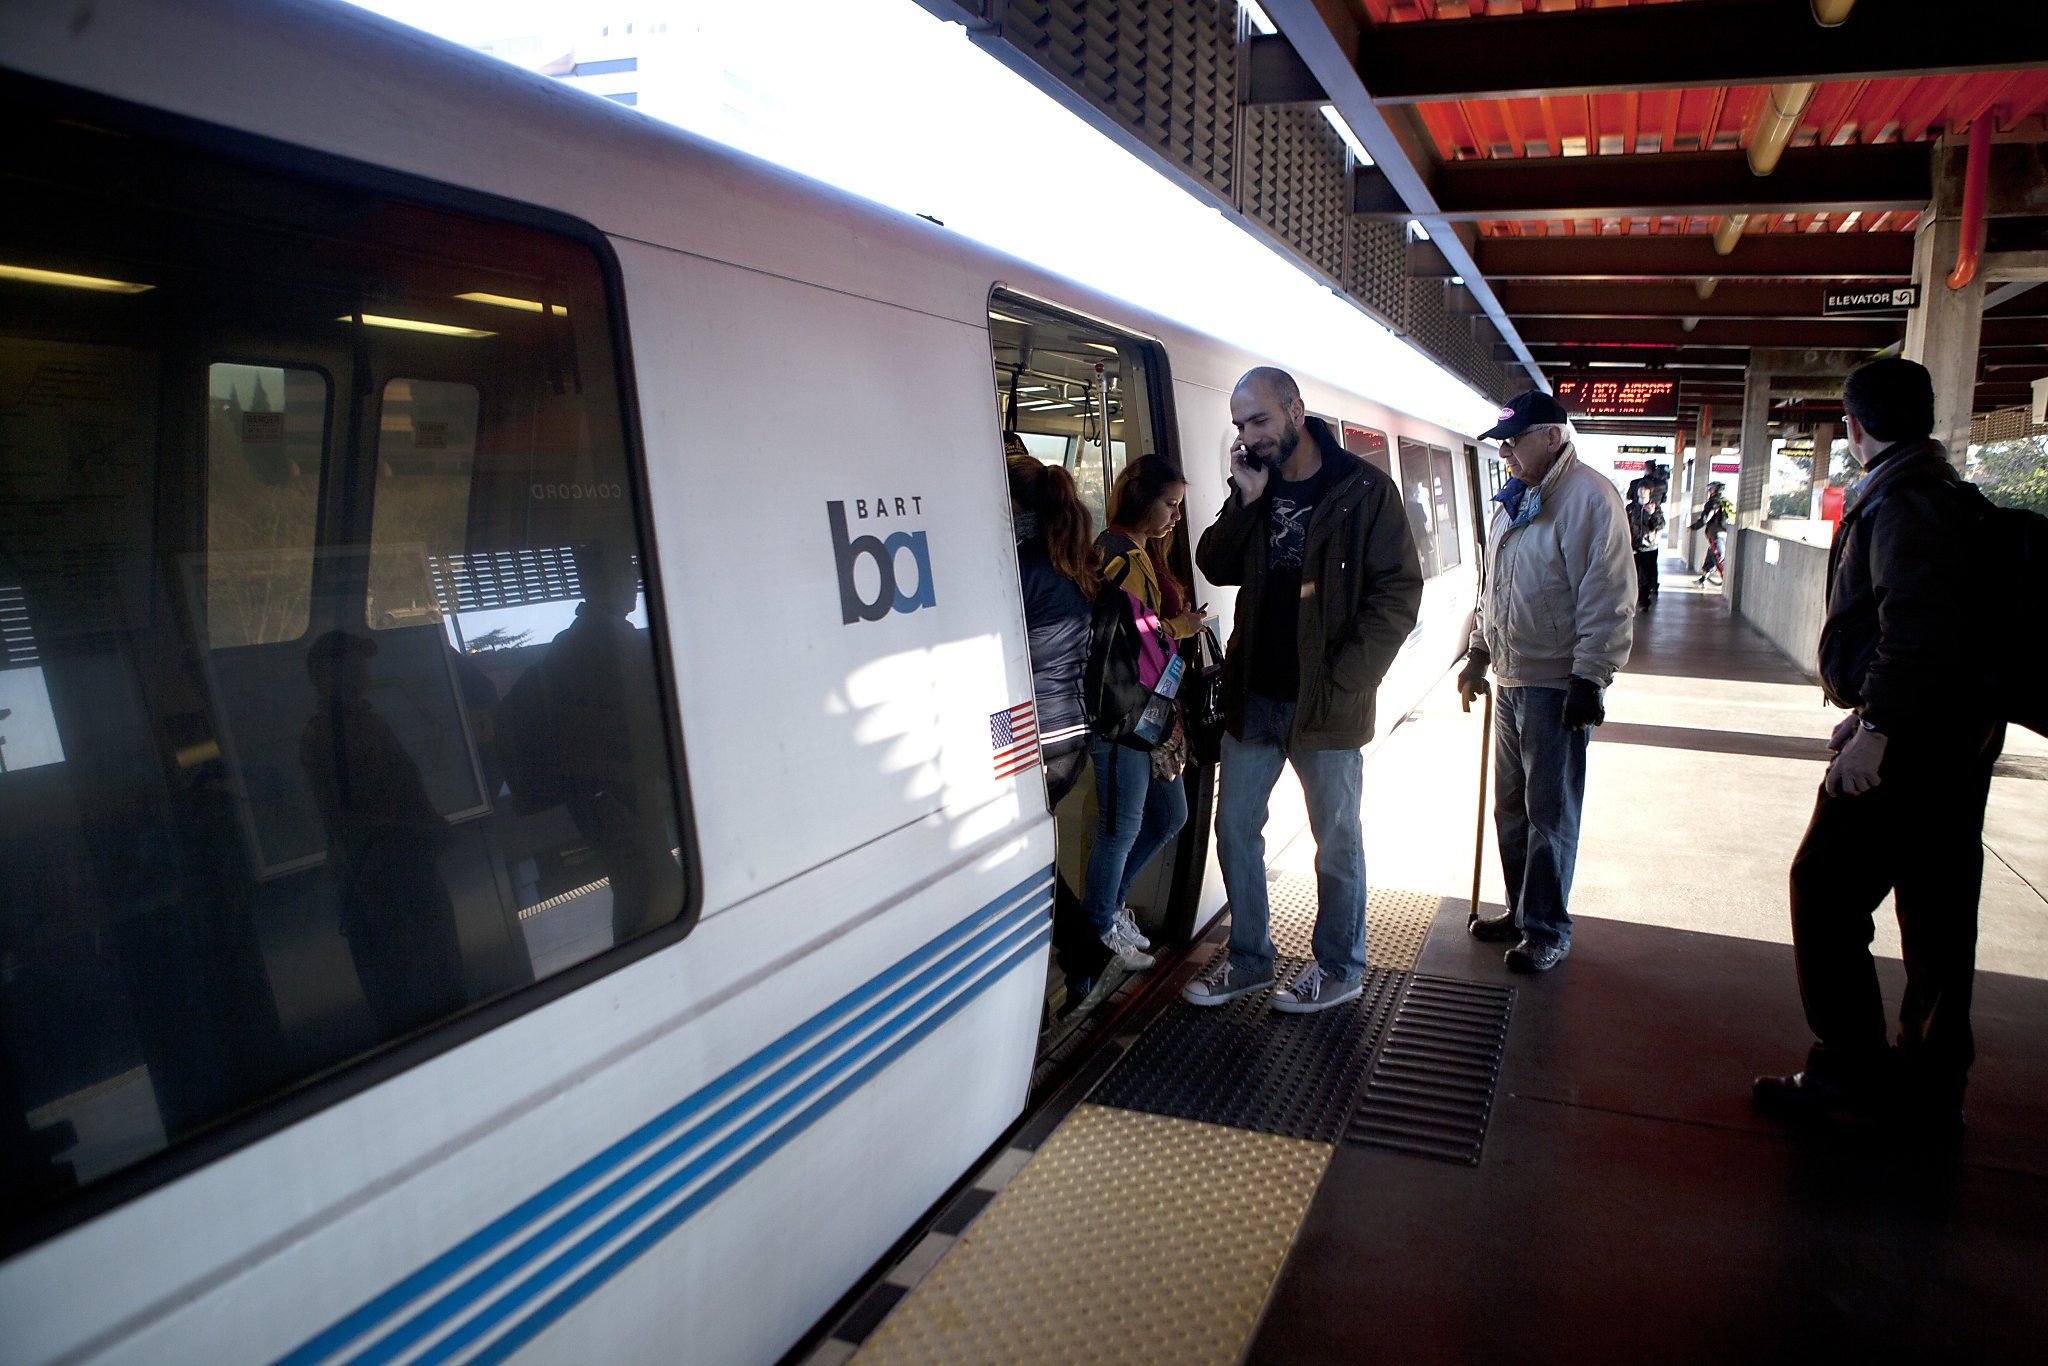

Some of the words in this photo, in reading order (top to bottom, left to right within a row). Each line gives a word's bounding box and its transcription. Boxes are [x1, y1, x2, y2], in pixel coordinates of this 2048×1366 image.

[1828, 293, 1890, 306] ELEVATOR
[856, 496, 922, 519] BART
[826, 500, 936, 625] ba
